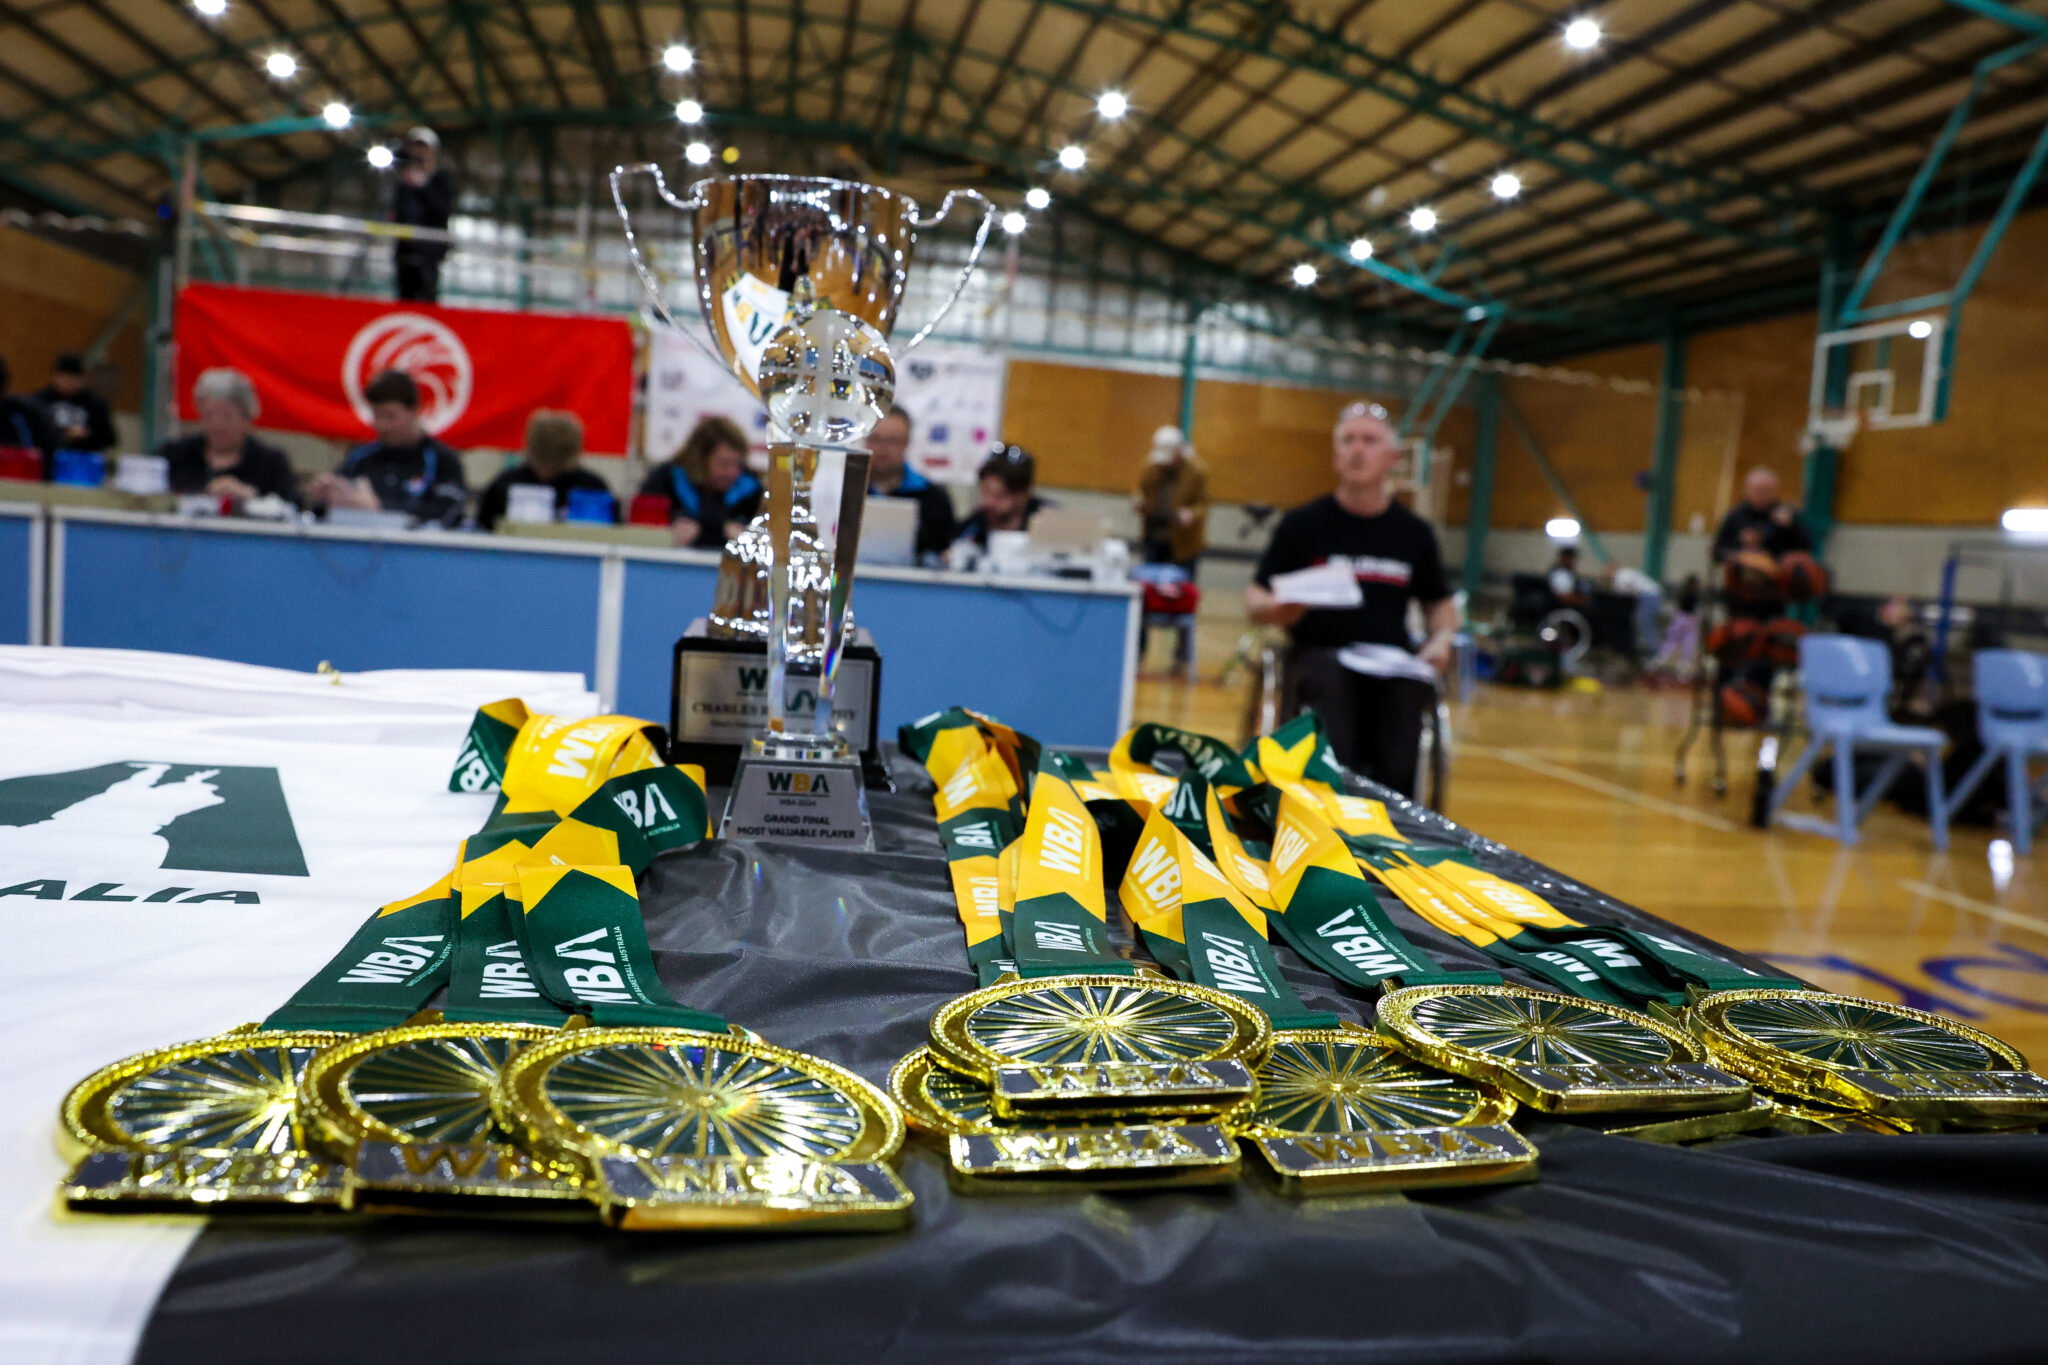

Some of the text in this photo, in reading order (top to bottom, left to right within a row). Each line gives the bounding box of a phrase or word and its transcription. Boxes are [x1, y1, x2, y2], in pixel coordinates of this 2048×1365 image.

[767, 772, 830, 793] WBA
[737, 826, 856, 839] MOST VALUABLE PLAYER
[764, 813, 830, 825] GRAND FINAL
[1039, 806, 1084, 876] WBA
[1357, 904, 1378, 931] AUSTRALIA
[613, 925, 630, 963] AUSTRALIA
[1035, 920, 1088, 953] WBA
[1316, 907, 1411, 977] WBA
[338, 934, 446, 984] WBA
[1202, 932, 1267, 994] WBA
[624, 963, 643, 994] BASKETBALL
